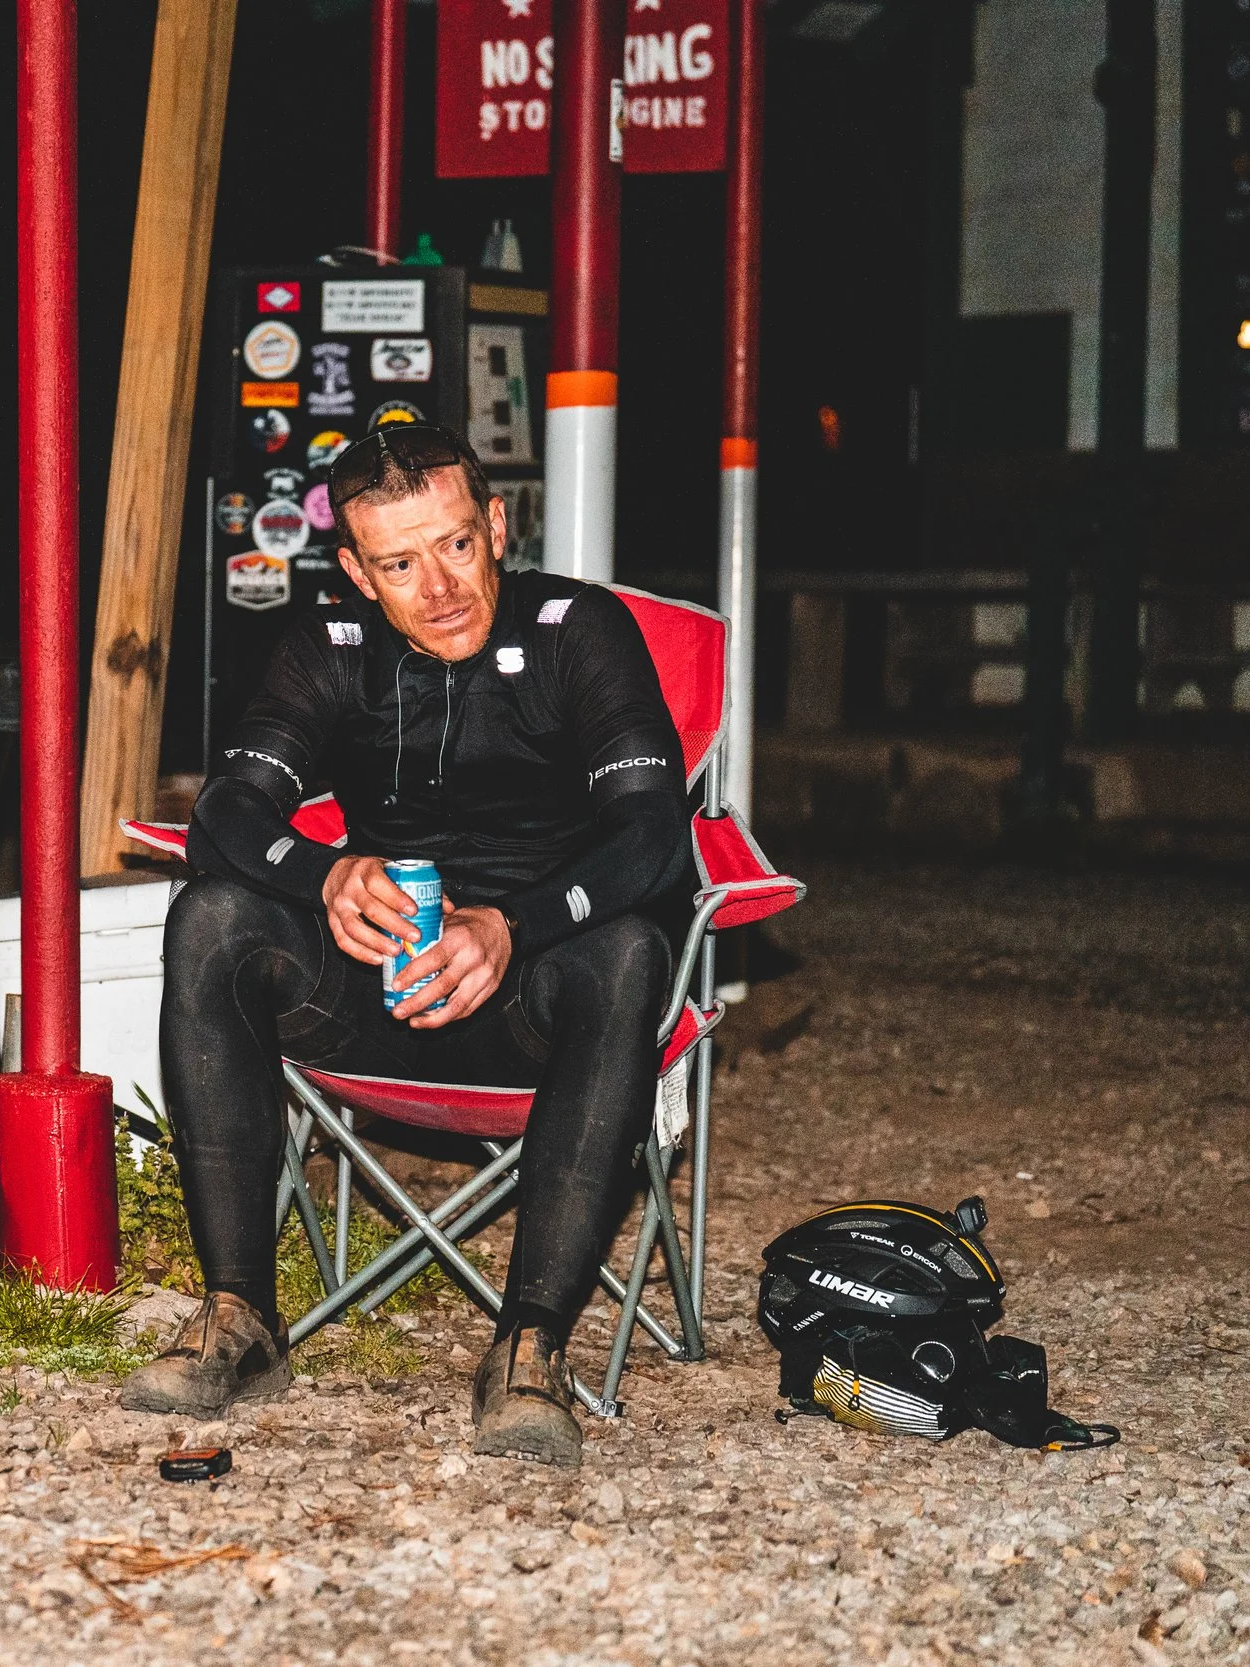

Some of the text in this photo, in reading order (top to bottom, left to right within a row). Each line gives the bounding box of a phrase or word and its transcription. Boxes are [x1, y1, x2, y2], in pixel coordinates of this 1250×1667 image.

[481, 39, 530, 88] NO
[478, 99, 551, 140] STO
[594, 757, 667, 780] ERGON
[912, 1252, 942, 1274] ERGON
[792, 1310, 825, 1332] CANYON
